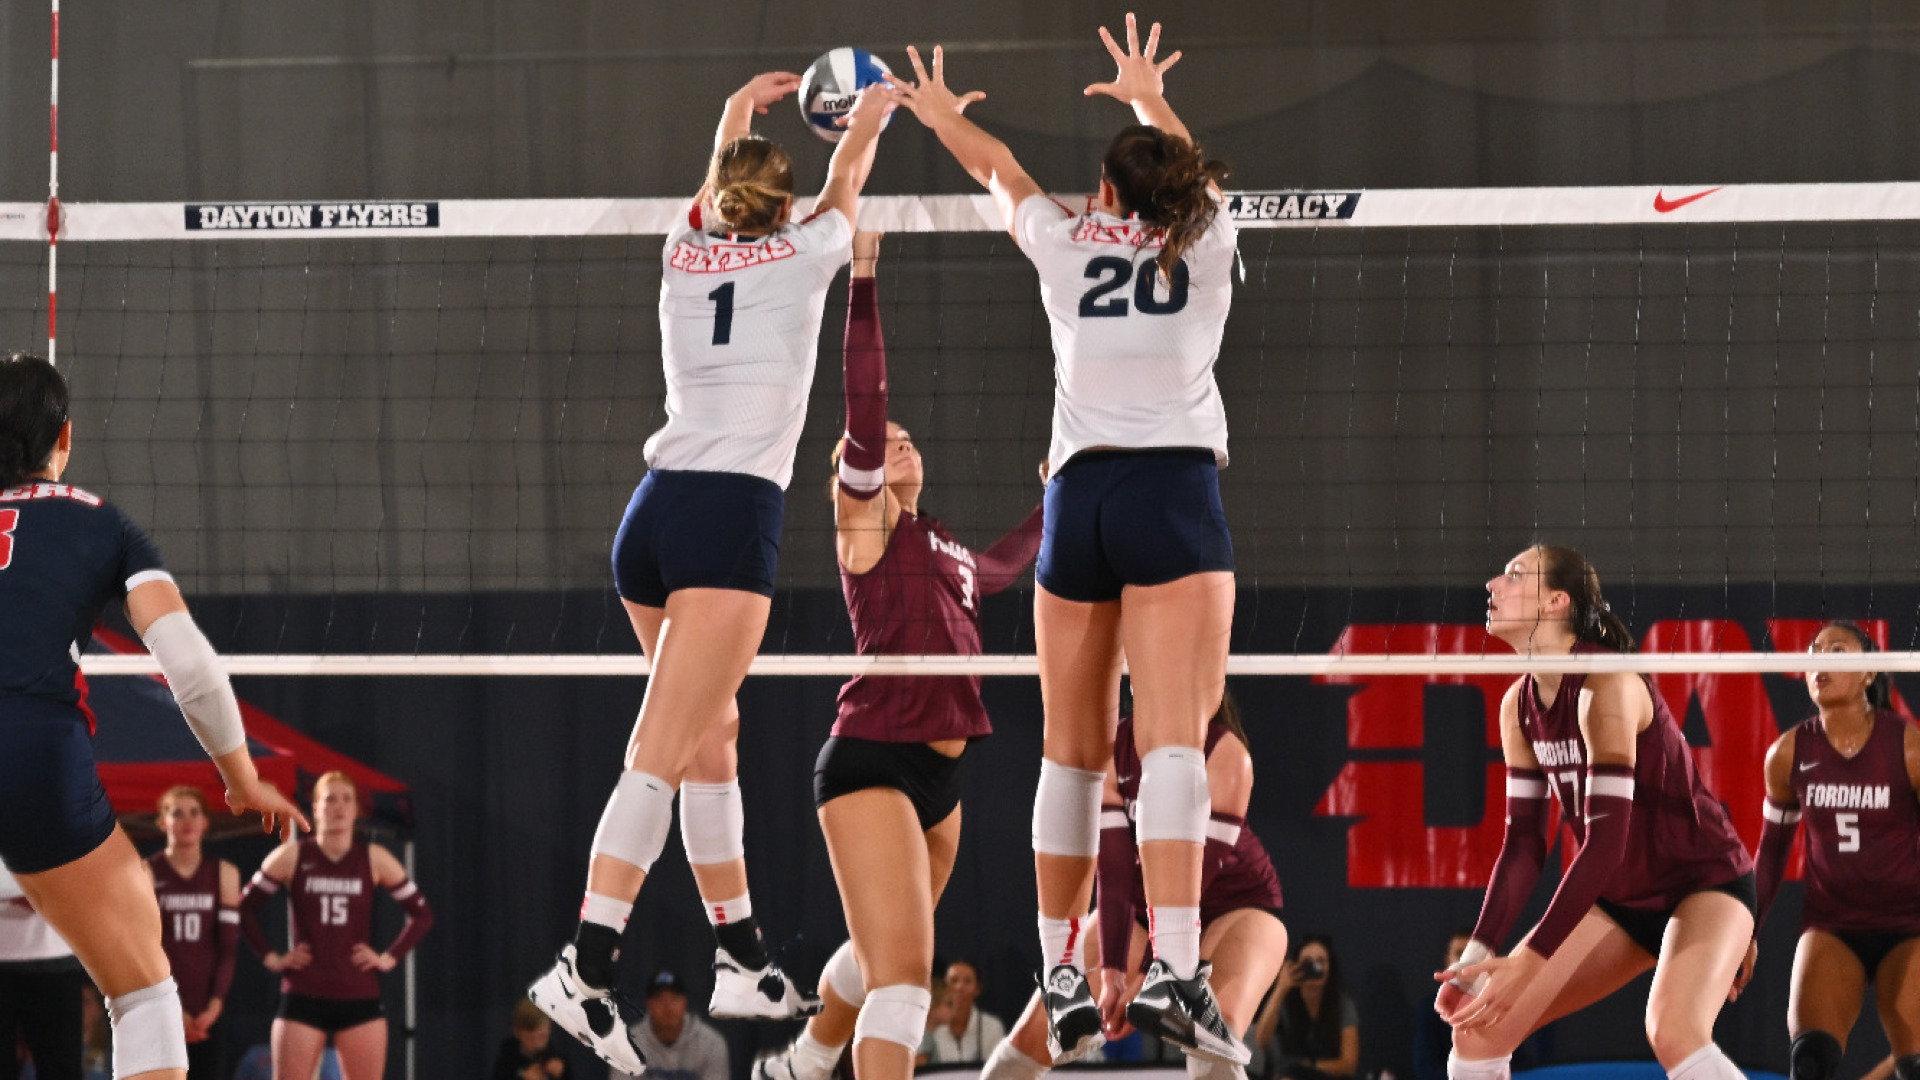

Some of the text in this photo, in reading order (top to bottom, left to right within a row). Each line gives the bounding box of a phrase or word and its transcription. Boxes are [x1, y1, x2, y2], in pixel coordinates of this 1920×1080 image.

[200, 203, 428, 230] DAYTON FLYERS
[1228, 194, 1347, 220] LEGACY
[1079, 255, 1189, 318] 20
[708, 280, 735, 346] 1
[1805, 783, 1891, 809] FORDHAM
[1835, 812, 1860, 853] 5
[319, 895, 349, 926] 15
[173, 912, 201, 942] 10
